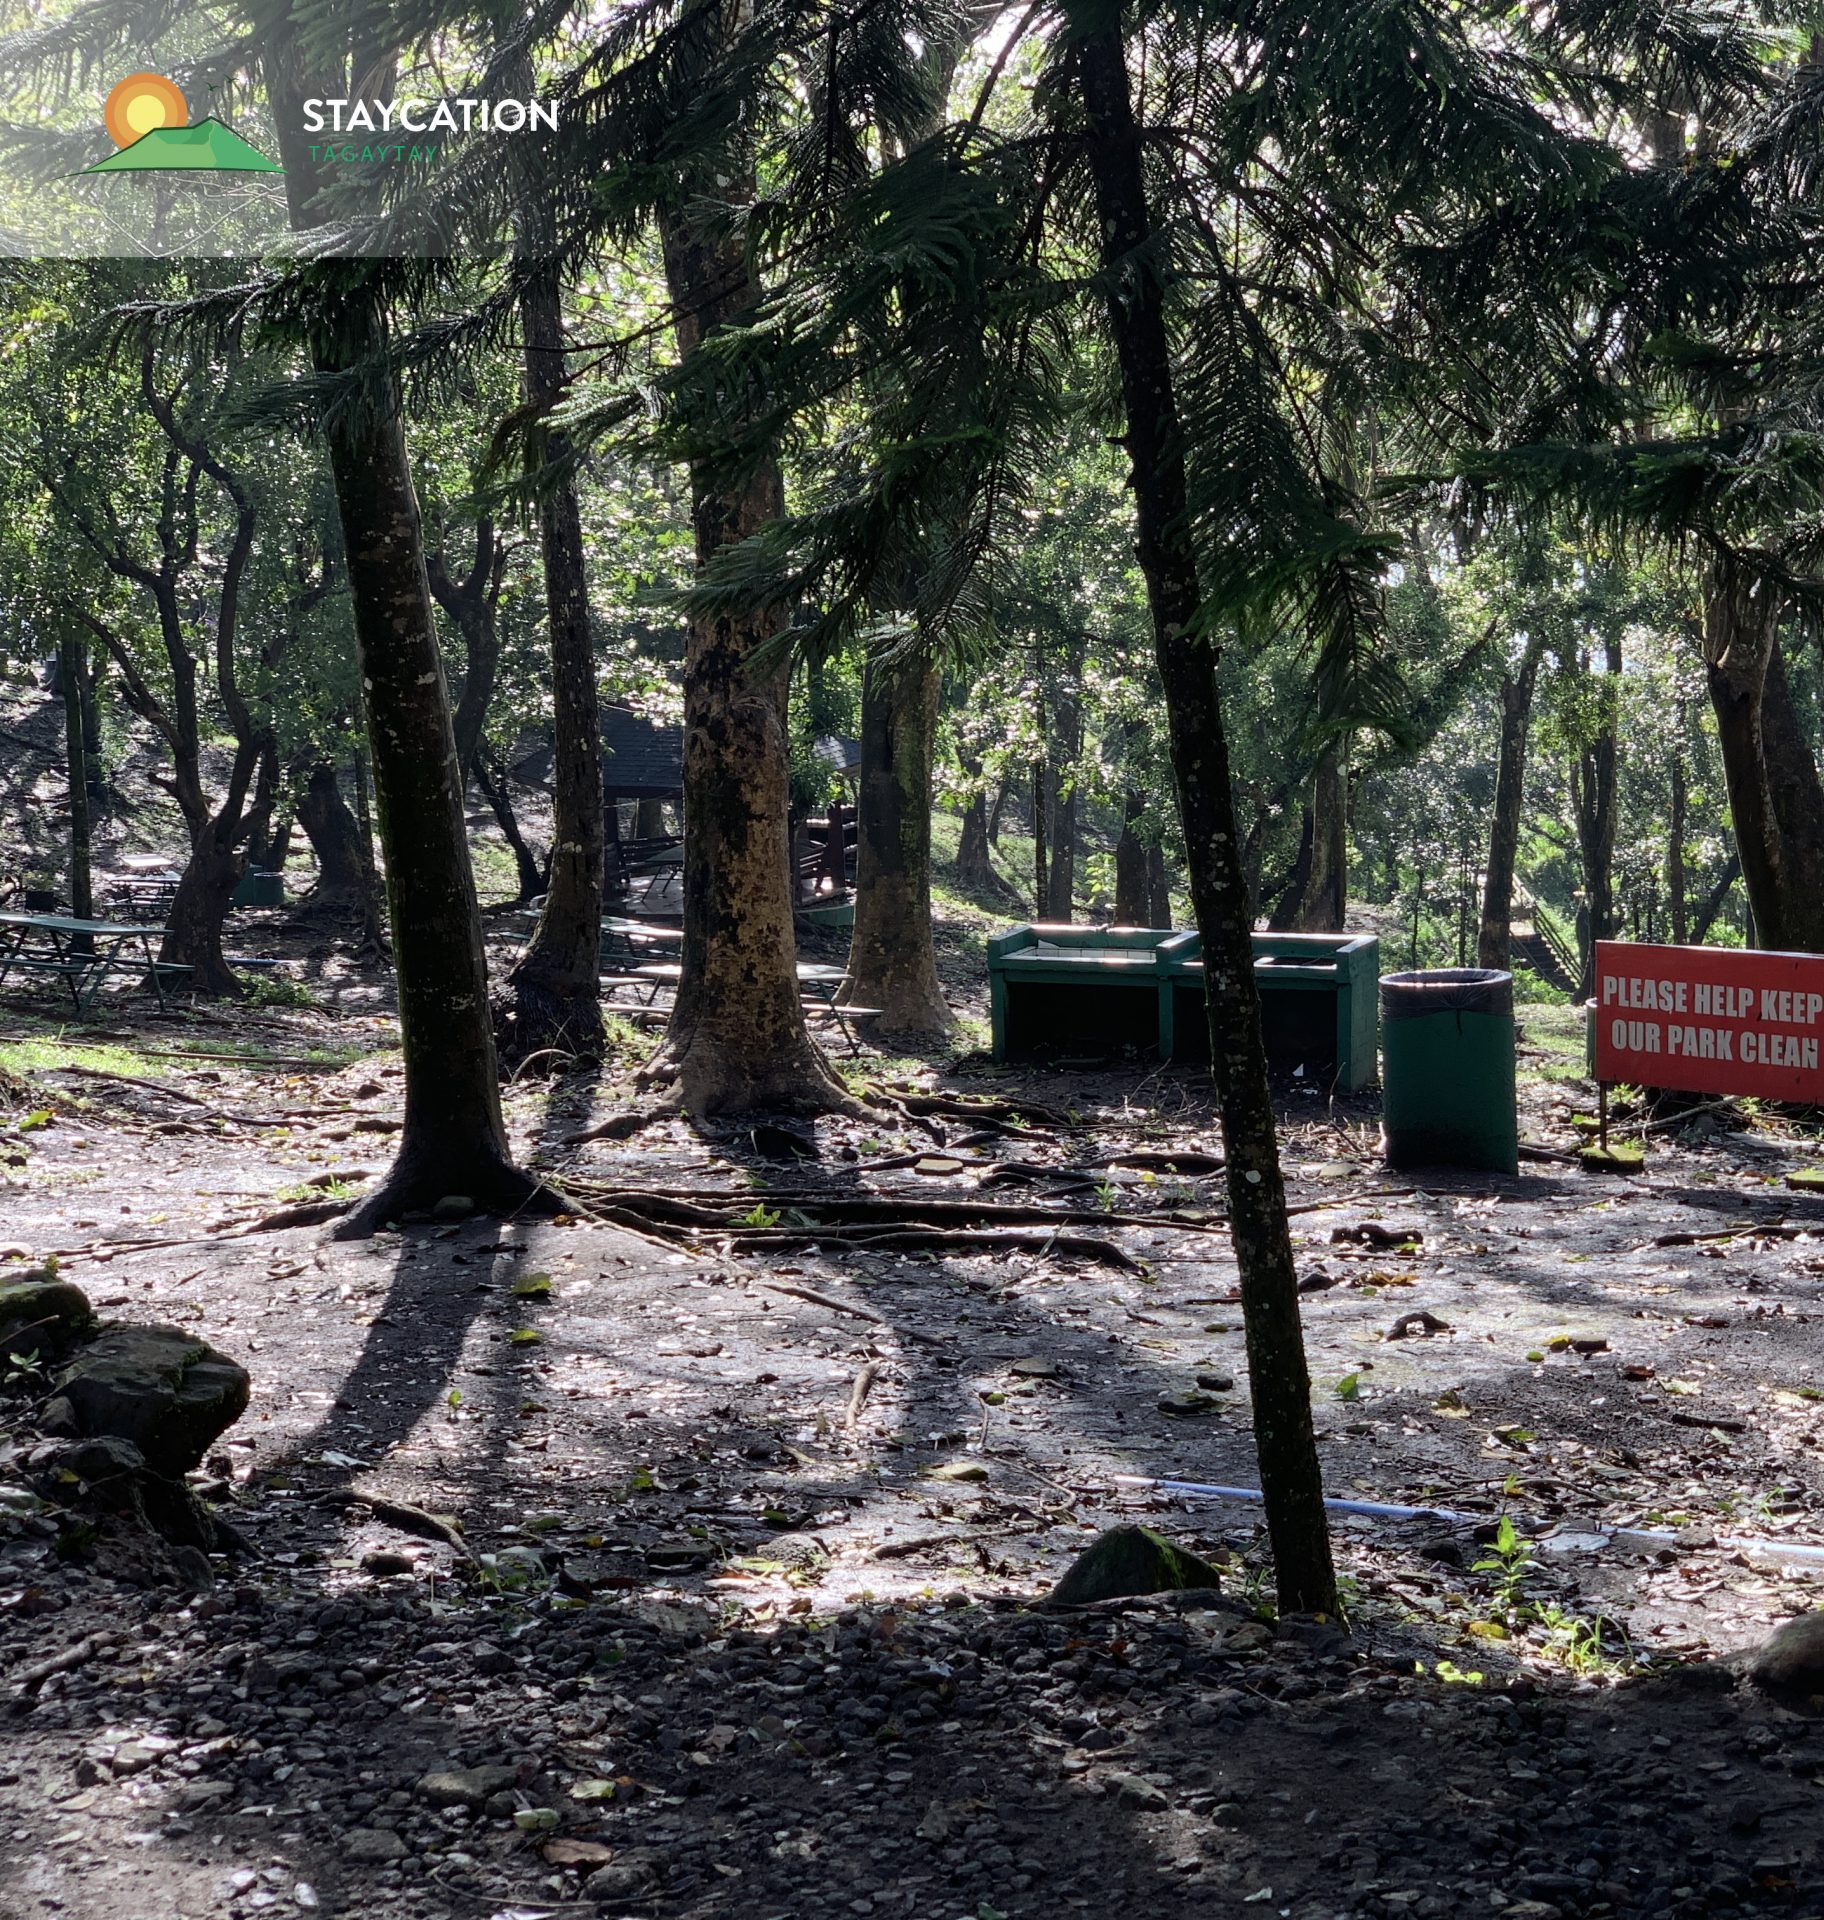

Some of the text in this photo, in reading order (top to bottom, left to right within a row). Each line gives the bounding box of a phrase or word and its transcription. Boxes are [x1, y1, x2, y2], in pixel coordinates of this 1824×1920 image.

[1603, 975, 1823, 1024] PLEASE HELP KEEP
[1611, 1019, 1819, 1069] OUR PARK CLEAN
